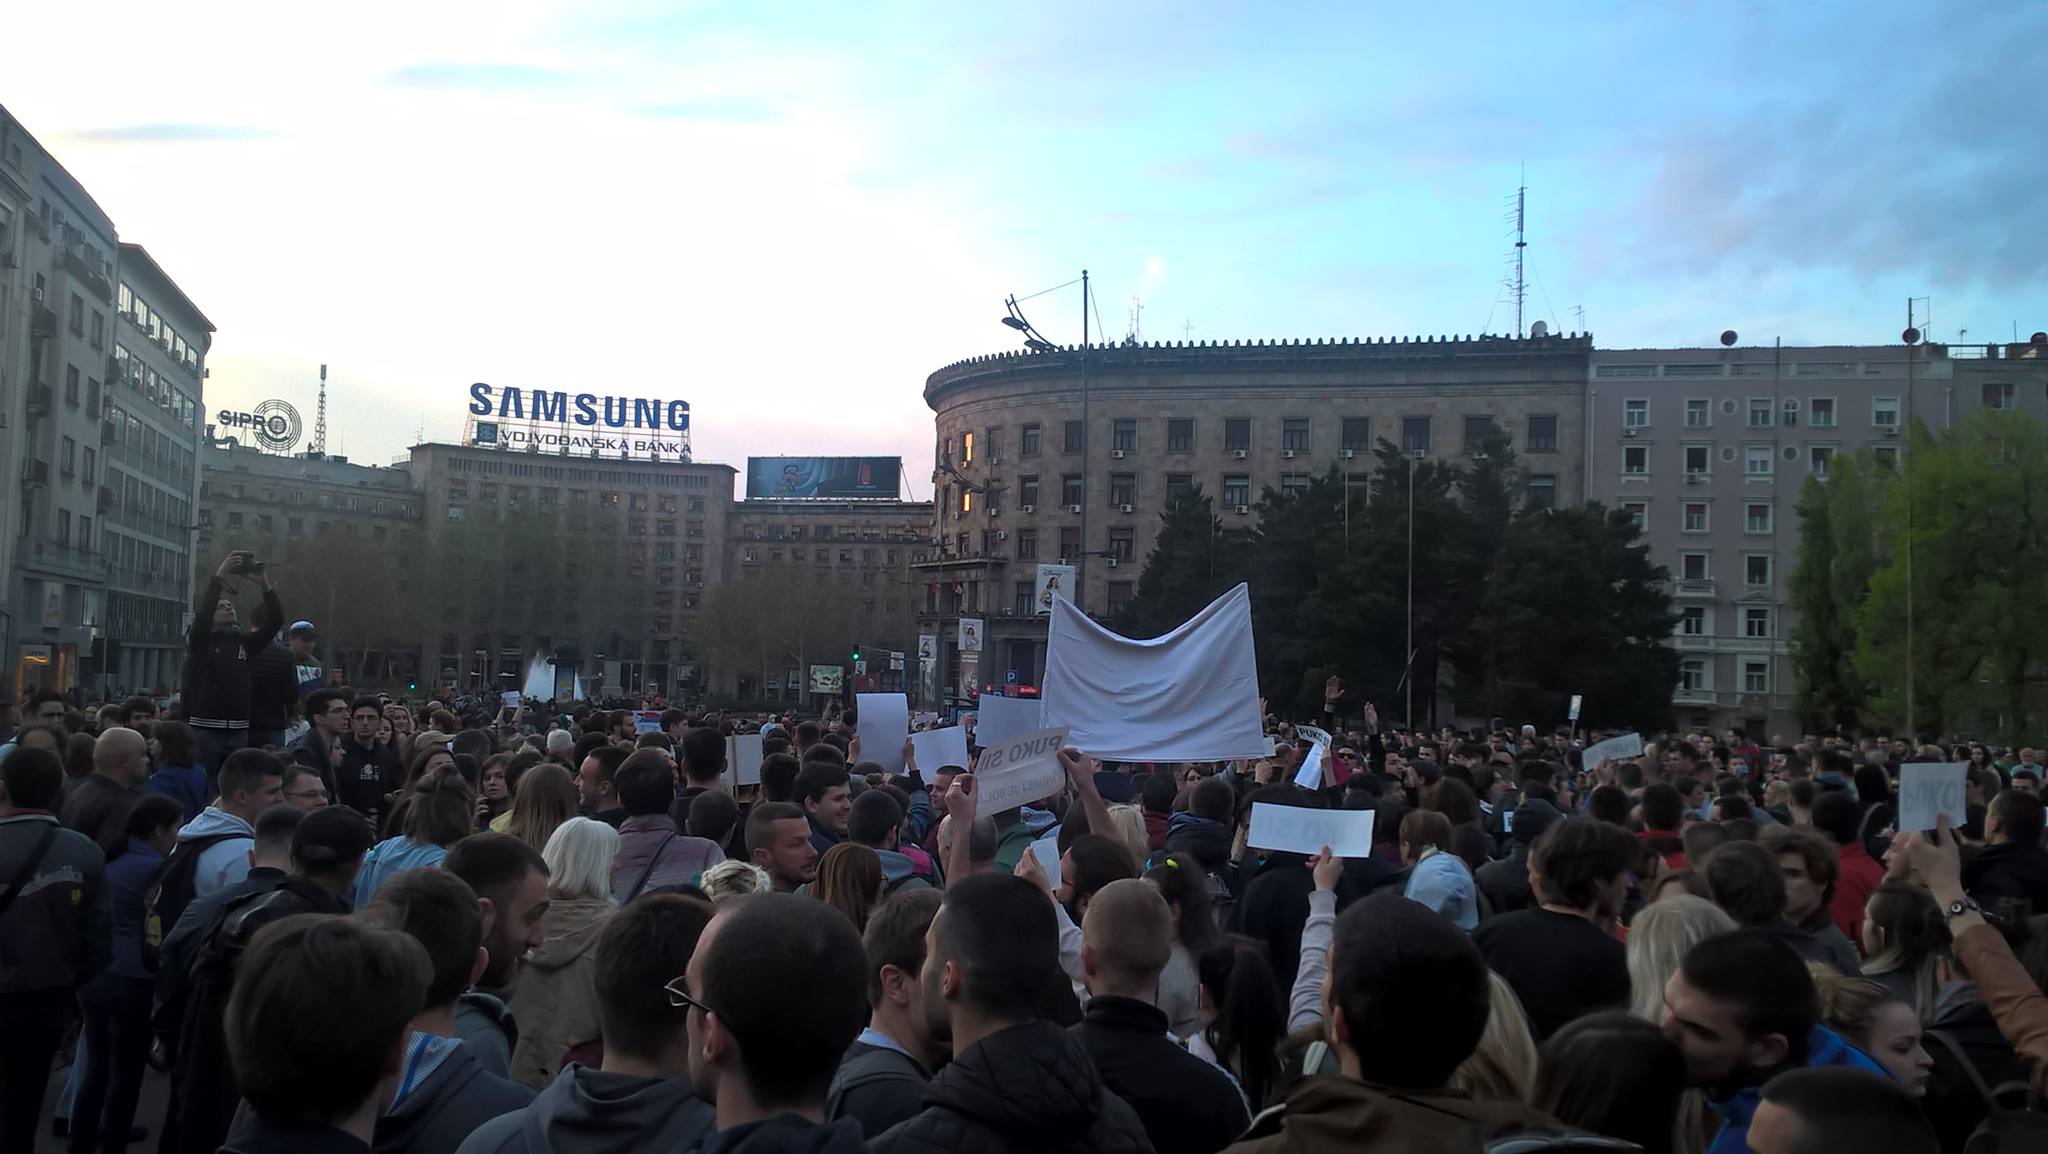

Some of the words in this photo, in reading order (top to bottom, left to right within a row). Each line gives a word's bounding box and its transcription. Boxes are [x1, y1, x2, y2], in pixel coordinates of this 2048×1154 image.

[469, 382, 690, 431] SAMSUNG
[634, 440, 692, 454] BANKA
[1007, 672, 1016, 682] P
